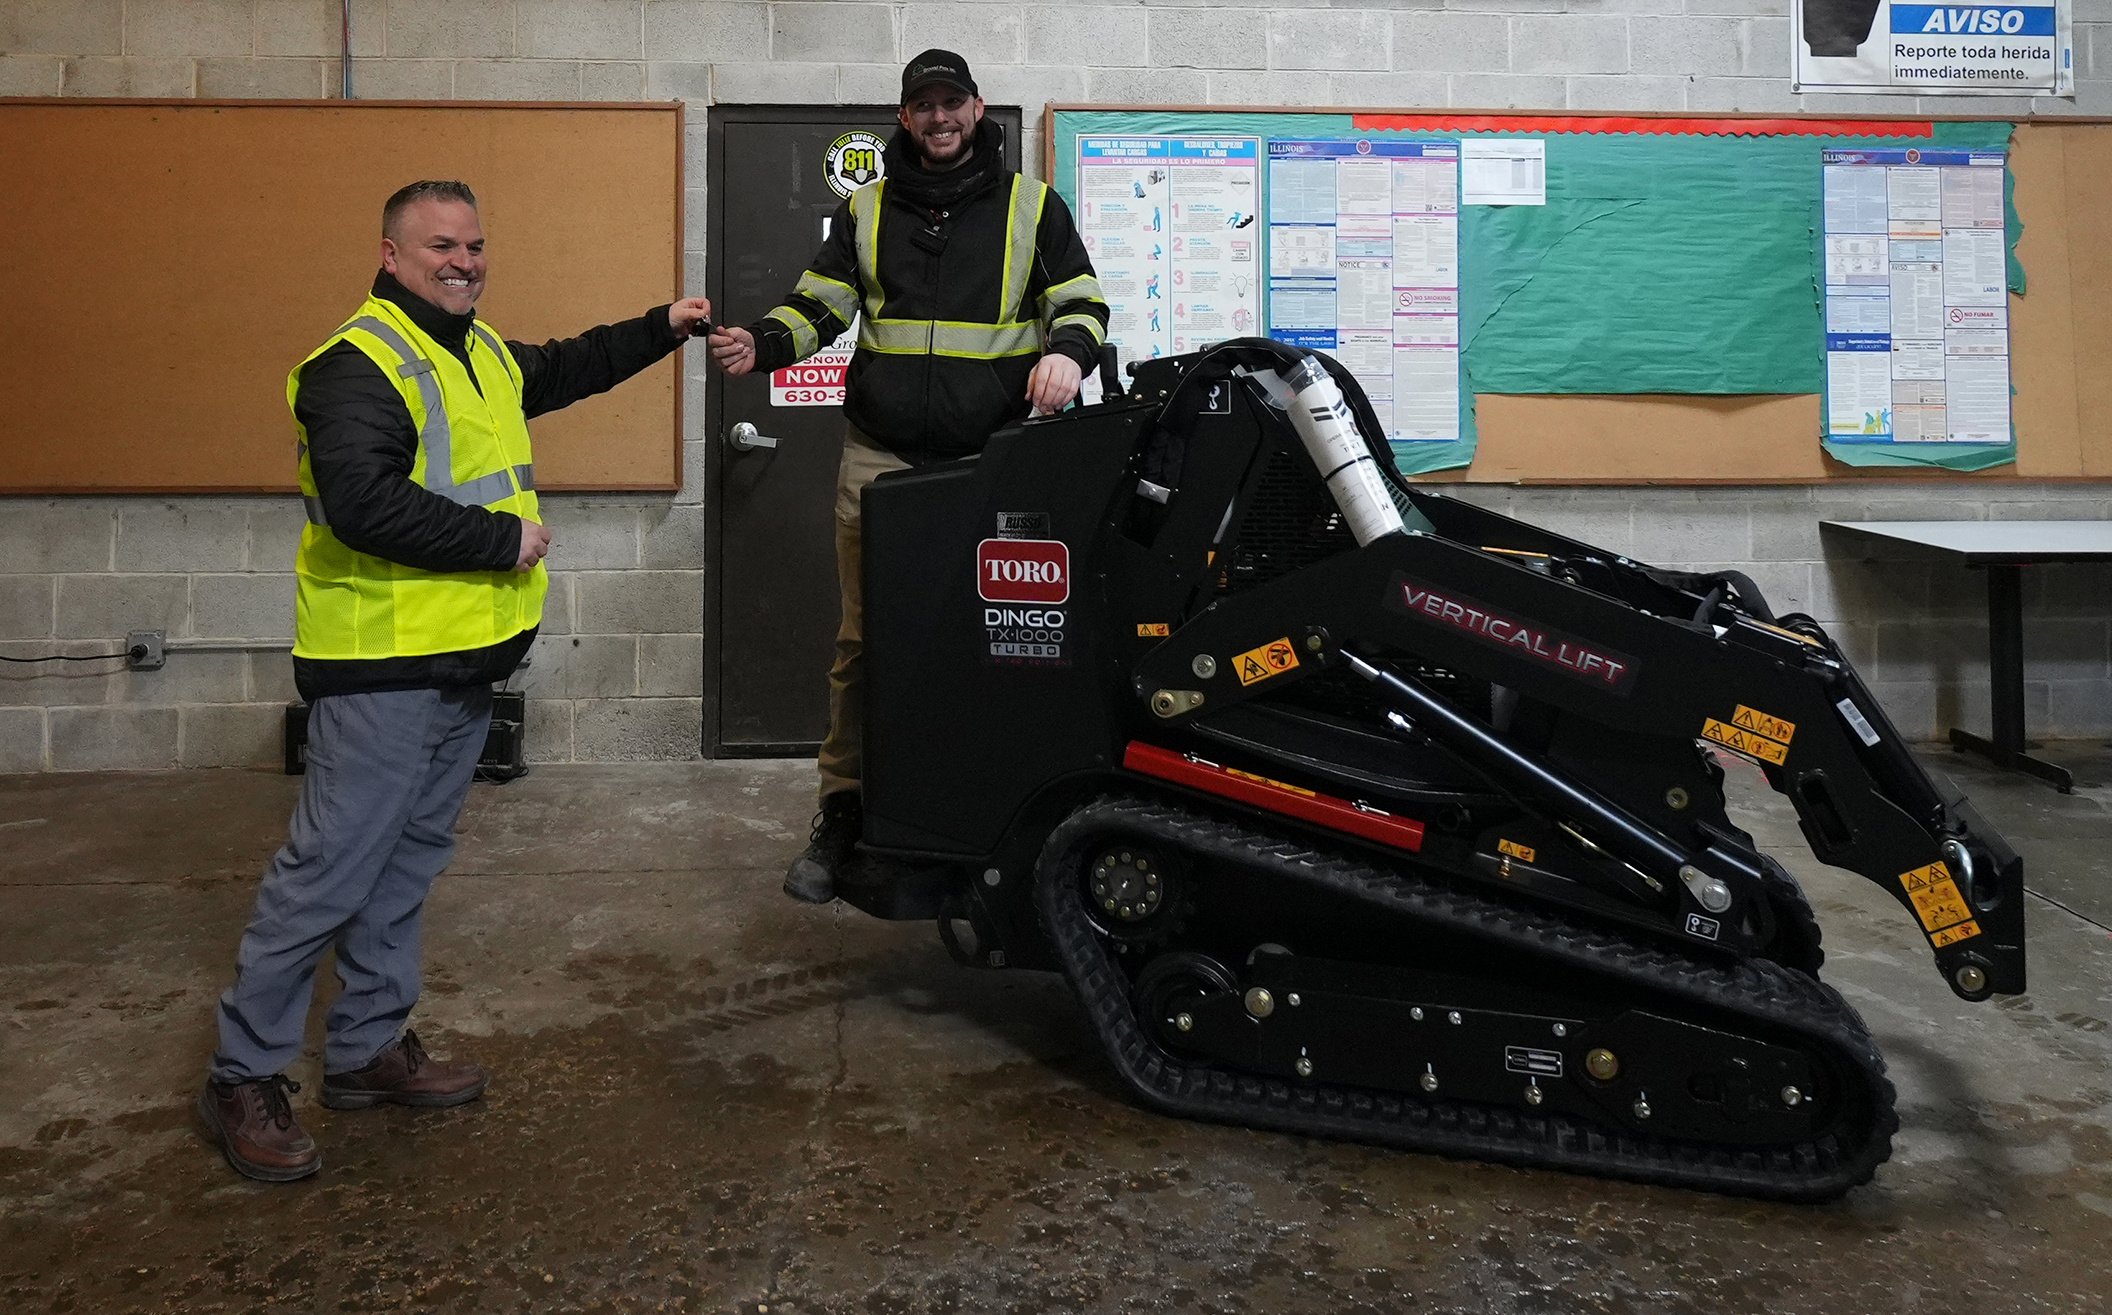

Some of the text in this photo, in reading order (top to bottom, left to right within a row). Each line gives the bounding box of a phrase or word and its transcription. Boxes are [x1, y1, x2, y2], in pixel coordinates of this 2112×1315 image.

[1922, 9, 2025, 33] AVISO
[1894, 44, 2051, 61] Reporte toda herida
[1894, 65, 2029, 80] immediatemente.
[827, 146, 840, 162] CALL
[851, 134, 875, 144] BEFORE
[1270, 144, 1304, 153] ILLINOIS
[844, 149, 874, 171] 811
[1823, 153, 1856, 161] ILLINOIS
[1173, 237, 1183, 252] 2
[1174, 270, 1184, 285] 3
[1174, 303, 1185, 318] 4
[1174, 336, 1185, 352] 5
[803, 356, 848, 365] SNOW
[785, 369, 841, 384] NOW
[985, 559, 1061, 584] TORO
[985, 608, 1065, 628] DINGO
[1403, 585, 1623, 680] VERTICAL LIFT
[993, 644, 1057, 656] TURBO
